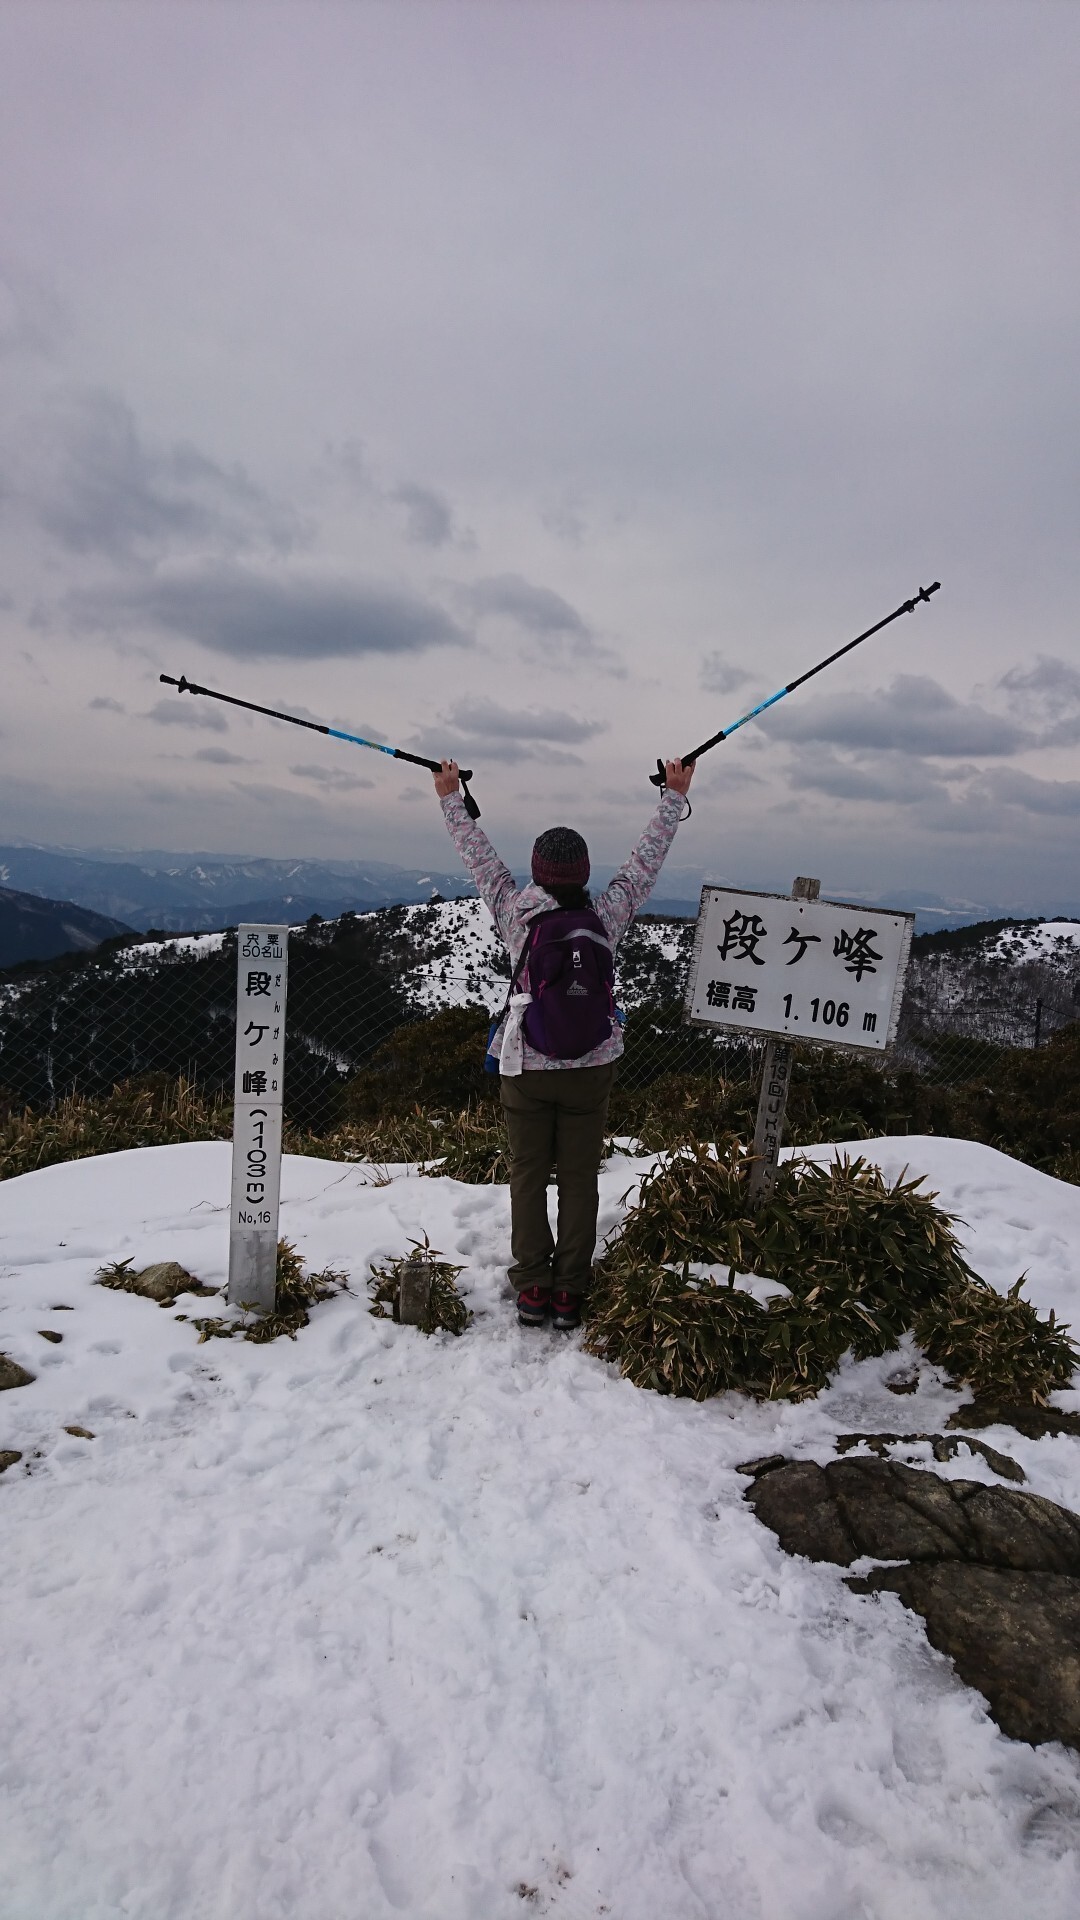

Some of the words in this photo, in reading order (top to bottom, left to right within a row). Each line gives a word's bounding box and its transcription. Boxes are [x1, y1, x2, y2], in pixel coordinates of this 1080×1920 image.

[242, 946, 283, 959] 50名山
[706, 980, 758, 1013] 標高
[862, 1012, 877, 1032] m
